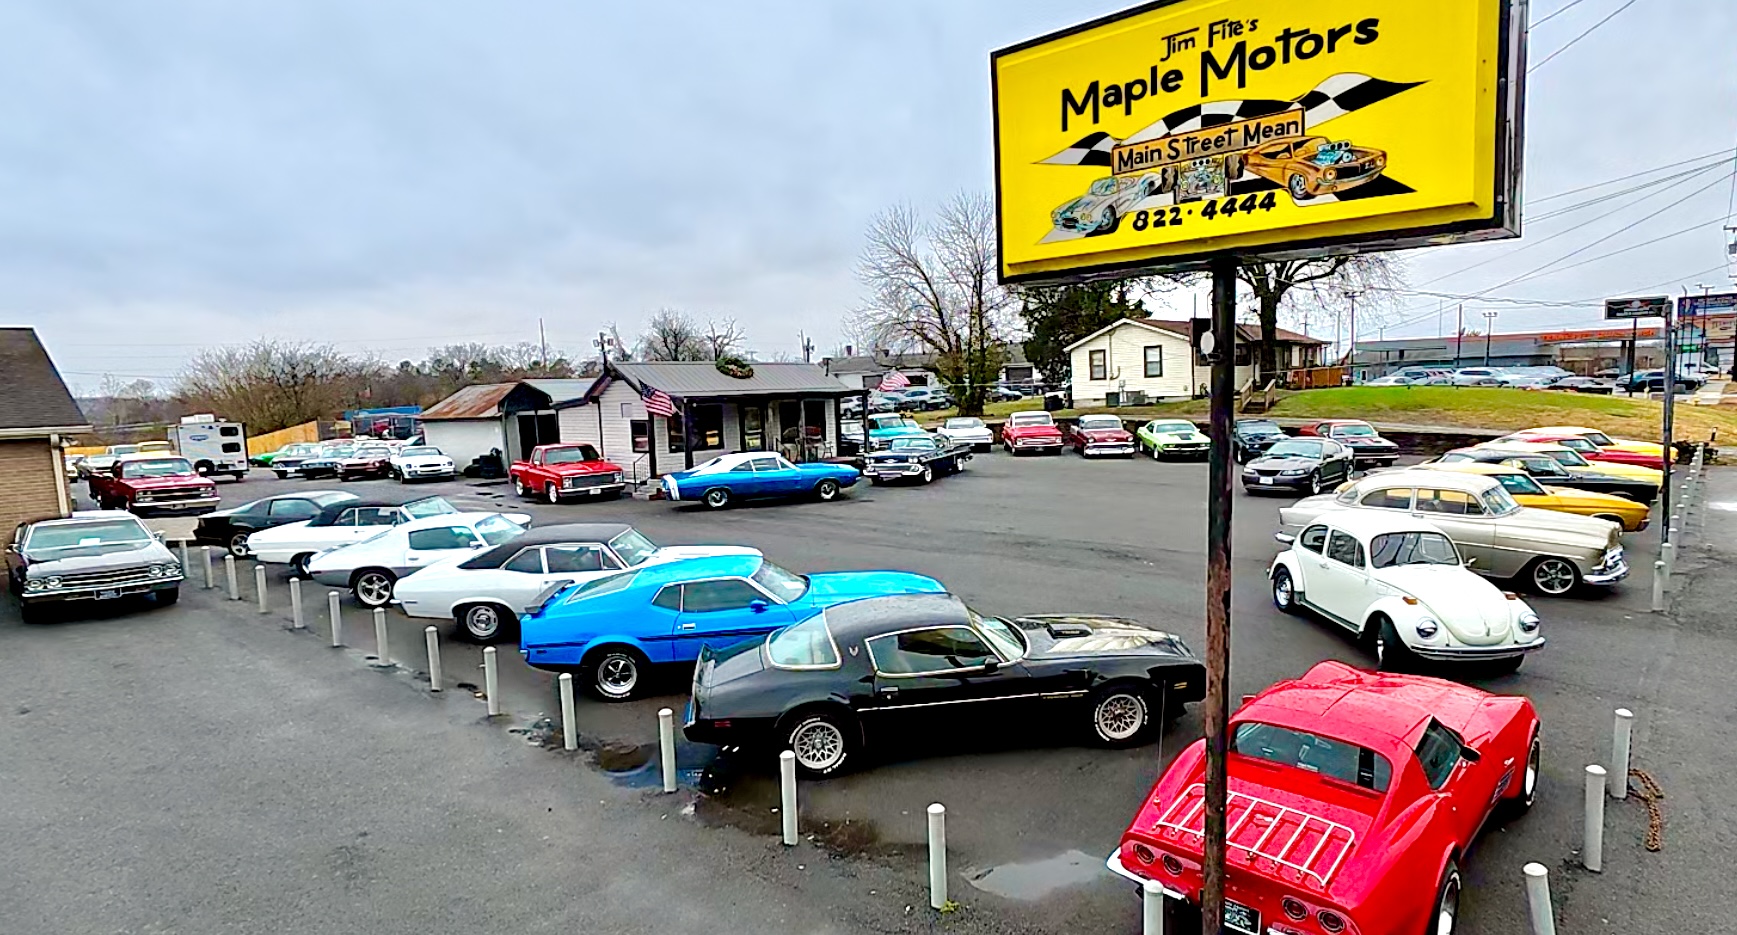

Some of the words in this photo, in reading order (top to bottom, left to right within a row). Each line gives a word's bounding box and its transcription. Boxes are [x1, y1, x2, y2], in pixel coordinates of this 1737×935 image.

[1160, 27, 1200, 62] Jim
[1208, 18, 1259, 48] Fite's
[1061, 65, 1184, 132] Maple
[1200, 18, 1380, 98] Motors
[1117, 146, 1161, 171] Main
[1167, 127, 1238, 161] Street
[1243, 120, 1299, 147] Mean
